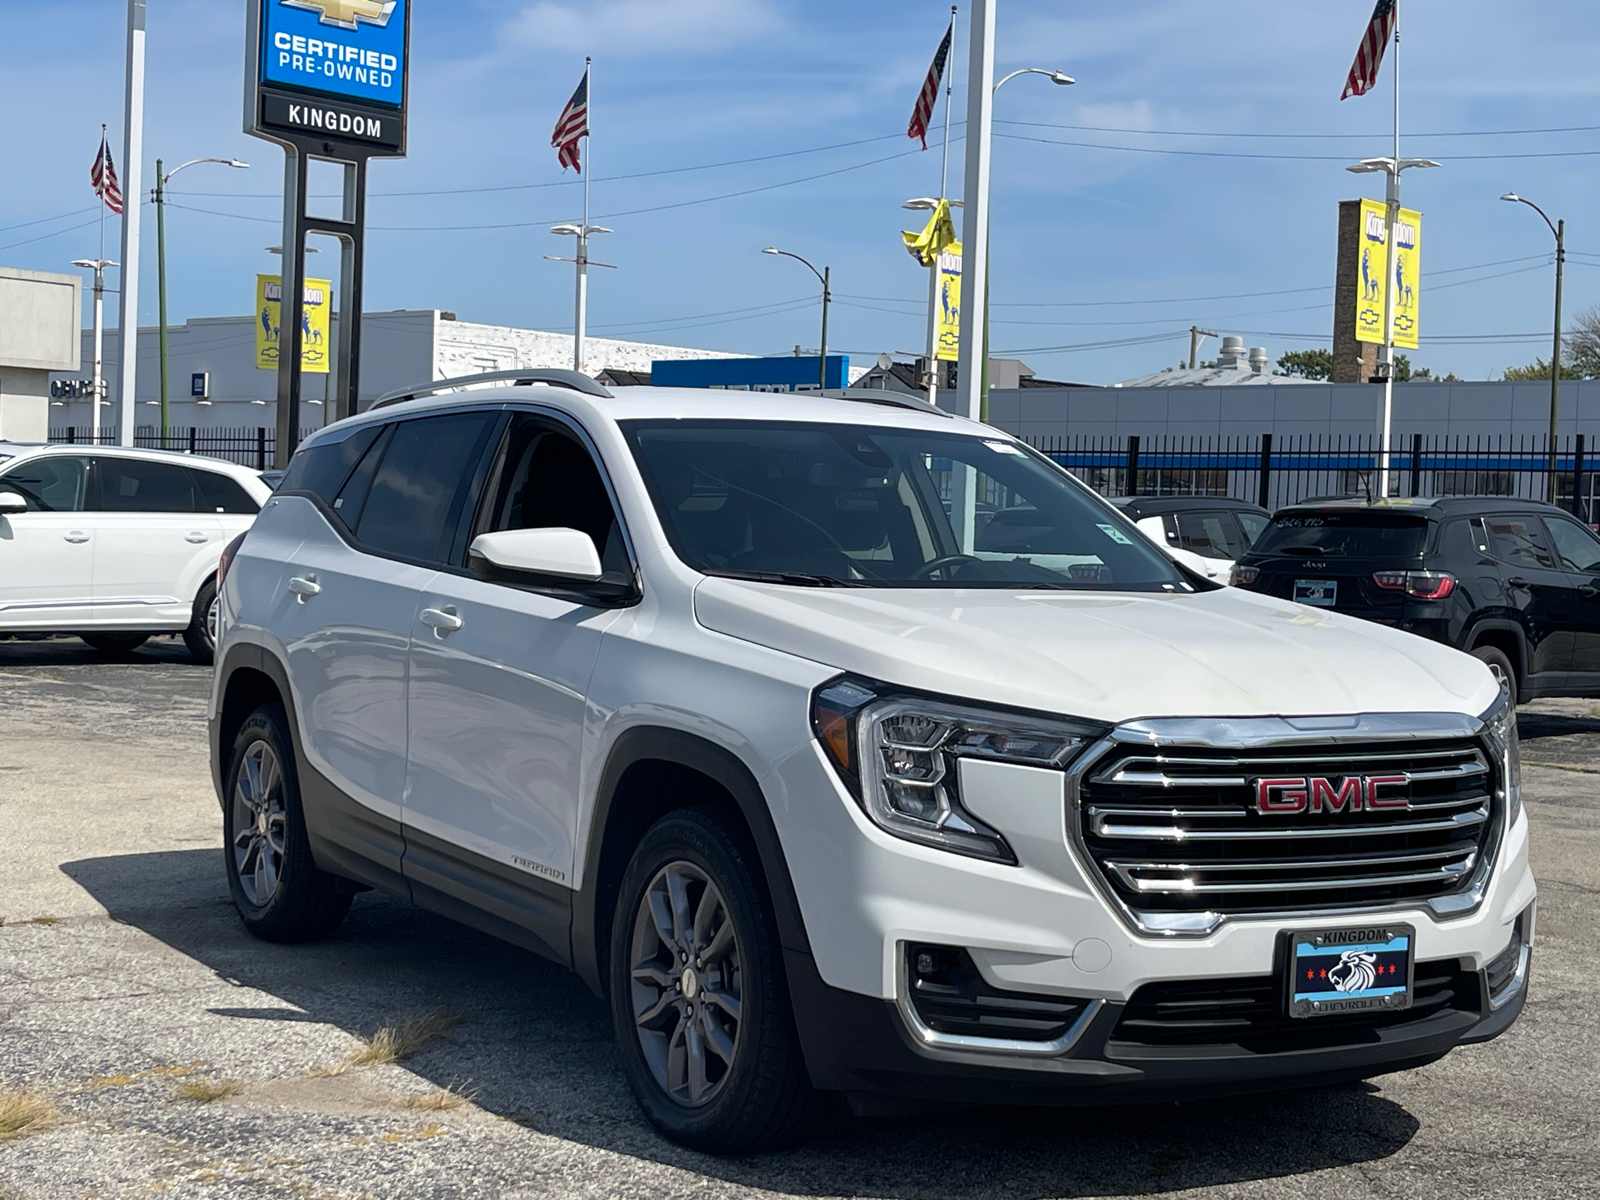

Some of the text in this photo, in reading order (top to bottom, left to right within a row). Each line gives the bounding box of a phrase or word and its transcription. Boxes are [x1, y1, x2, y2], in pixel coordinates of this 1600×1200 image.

[274, 31, 397, 72] CERTIFIED
[279, 51, 392, 88] PRE-OWNED
[288, 104, 381, 138] KINGDOM
[1257, 775, 1408, 815] GMC
[1323, 929, 1387, 944] KINGDOM
[1319, 999, 1383, 1012] CHEVROLET
